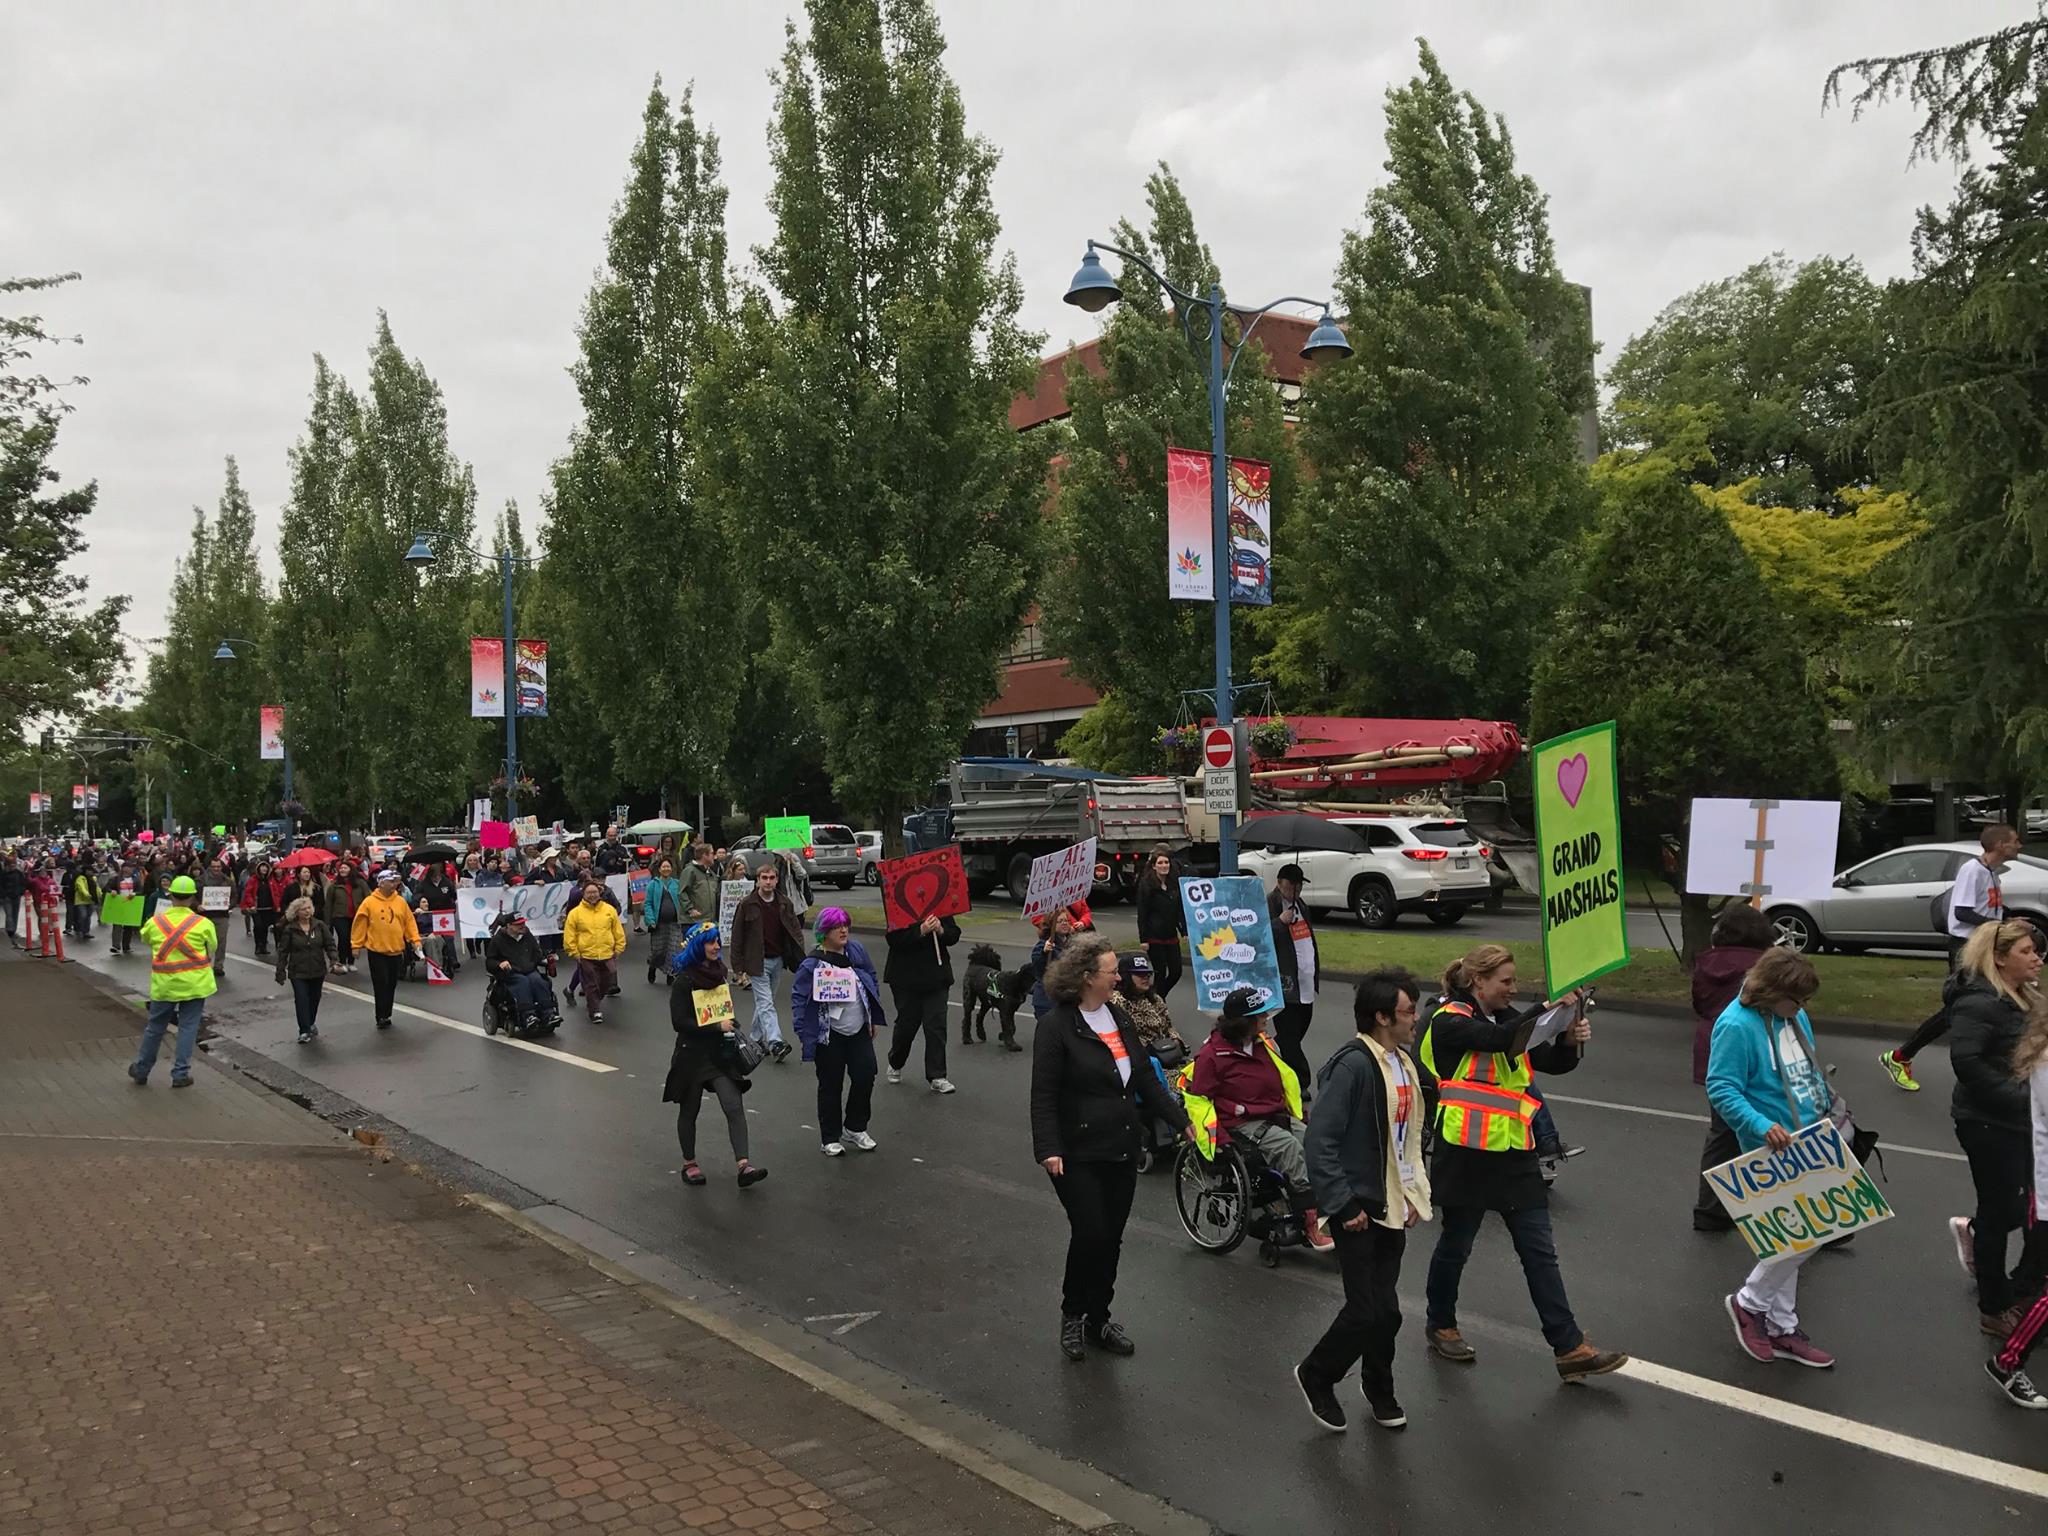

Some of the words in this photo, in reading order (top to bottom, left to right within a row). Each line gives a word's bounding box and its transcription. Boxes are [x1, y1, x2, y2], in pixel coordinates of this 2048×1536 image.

[1211, 776, 1229, 784] EXCEPT
[1206, 789, 1234, 797] EMERGENCY
[1209, 801, 1233, 809] VEHICLES
[1033, 855, 1053, 878] WE
[1061, 842, 1087, 868] ARE
[1553, 832, 1601, 877] GRAND
[1030, 862, 1091, 895] CELEBRATING
[1188, 883, 1213, 902] CP
[1547, 869, 1619, 931] MARSHALS
[1024, 896, 1052, 915] DOWN
[1196, 911, 1205, 920] is
[1212, 909, 1228, 918] like
[1231, 914, 1254, 923] being
[1222, 947, 1254, 959] Royalty
[1203, 971, 1231, 982] You're
[819, 990, 850, 1000] Friends!
[1211, 990, 1230, 998] born
[1711, 1124, 1845, 1200] VISIBILITY
[1735, 1168, 1890, 1260] INCLUSION
